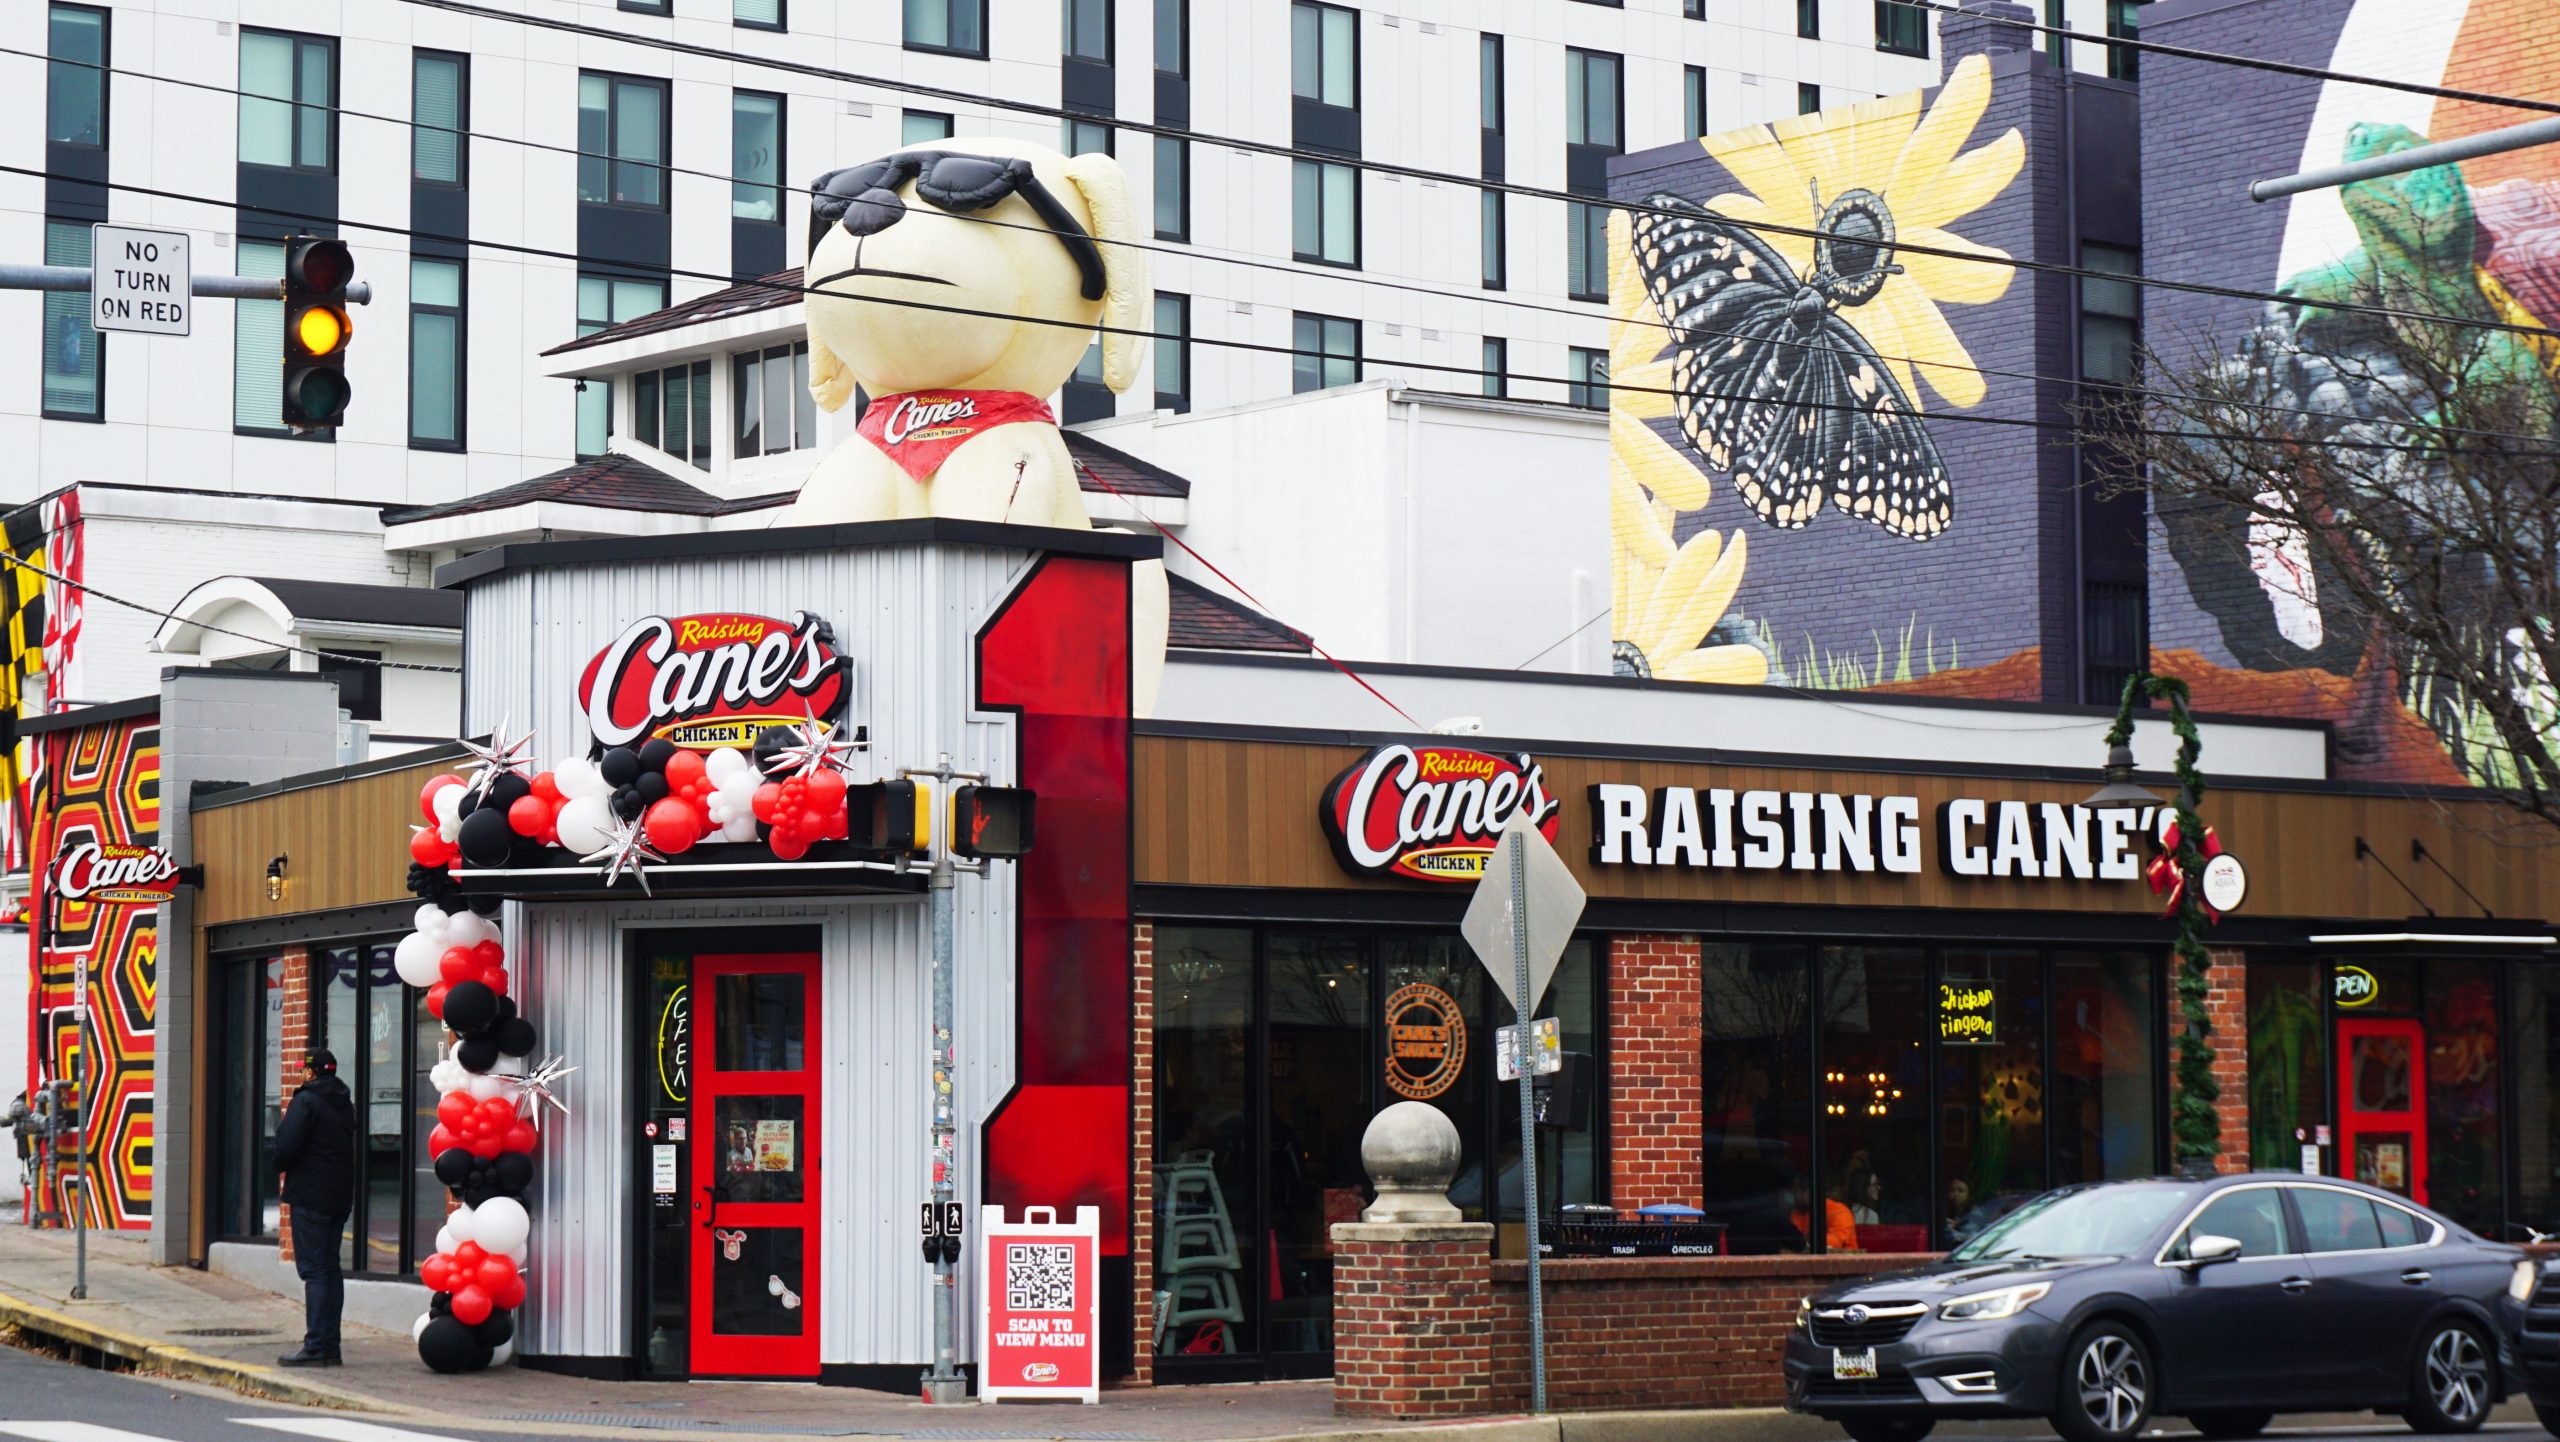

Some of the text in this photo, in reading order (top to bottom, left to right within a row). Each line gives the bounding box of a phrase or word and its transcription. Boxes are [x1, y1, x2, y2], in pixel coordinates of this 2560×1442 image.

[126, 241, 158, 262] NO
[114, 269, 170, 293] TURN
[102, 297, 182, 322] ON RED
[918, 395, 953, 406] Raising
[884, 396, 980, 444] Cane's
[679, 617, 765, 646] Raising
[588, 610, 838, 747] Cane's
[672, 726, 739, 743] CHICKEN
[1421, 752, 1495, 780] Raising
[1346, 744, 1559, 868] Cane's
[1599, 782, 1922, 873] RAISING
[103, 845, 145, 858] Raising
[59, 842, 180, 898] Cane's
[1417, 854, 1476, 871] CHICKEN
[2335, 974, 2370, 997] PEN
[1394, 1025, 1447, 1041] CANE'S
[1394, 1042, 1446, 1058] SAUCE
[1612, 1246, 1636, 1254] TRASH
[1678, 1246, 1708, 1254] RECYCLE
[1008, 1318, 1073, 1332] SCAN TO
[995, 1333, 1086, 1347] VIEW MENU
